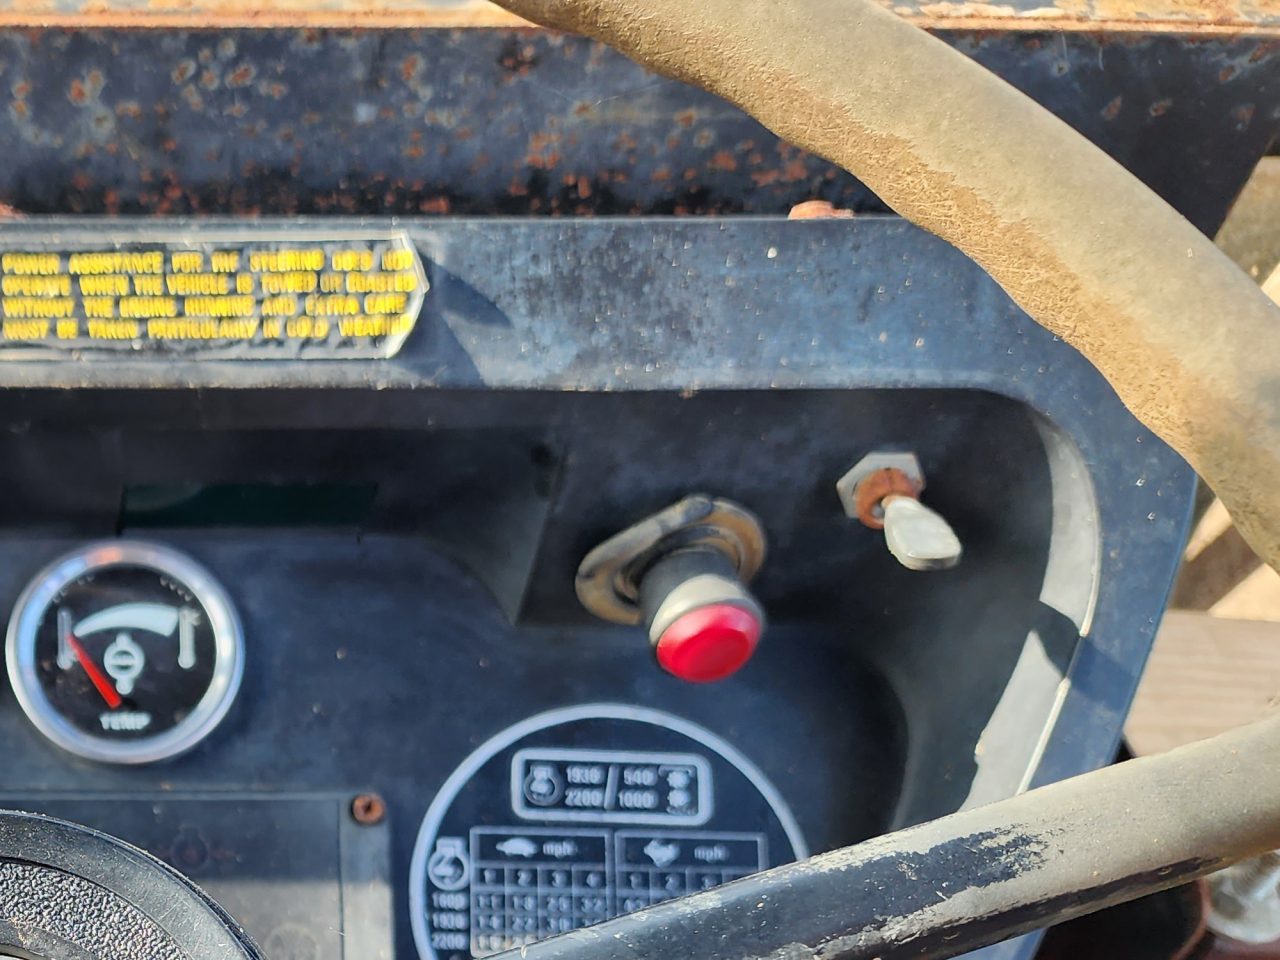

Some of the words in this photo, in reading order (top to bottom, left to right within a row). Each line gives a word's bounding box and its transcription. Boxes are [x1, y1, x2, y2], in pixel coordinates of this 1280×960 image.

[69, 252, 163, 274] ASSISTANCE
[172, 252, 203, 274] FOR
[250, 250, 324, 272] STEERING
[79, 274, 129, 296] WHEN
[133, 274, 163, 295] THE
[166, 273, 229, 295] VEHICLE
[2, 297, 75, 318] WITHOUT
[83, 296, 114, 318] THE
[261, 295, 297, 316] AND
[100, 712, 151, 730] TEMP
[624, 767, 657, 786] 540
[565, 788, 604, 807] 2200
